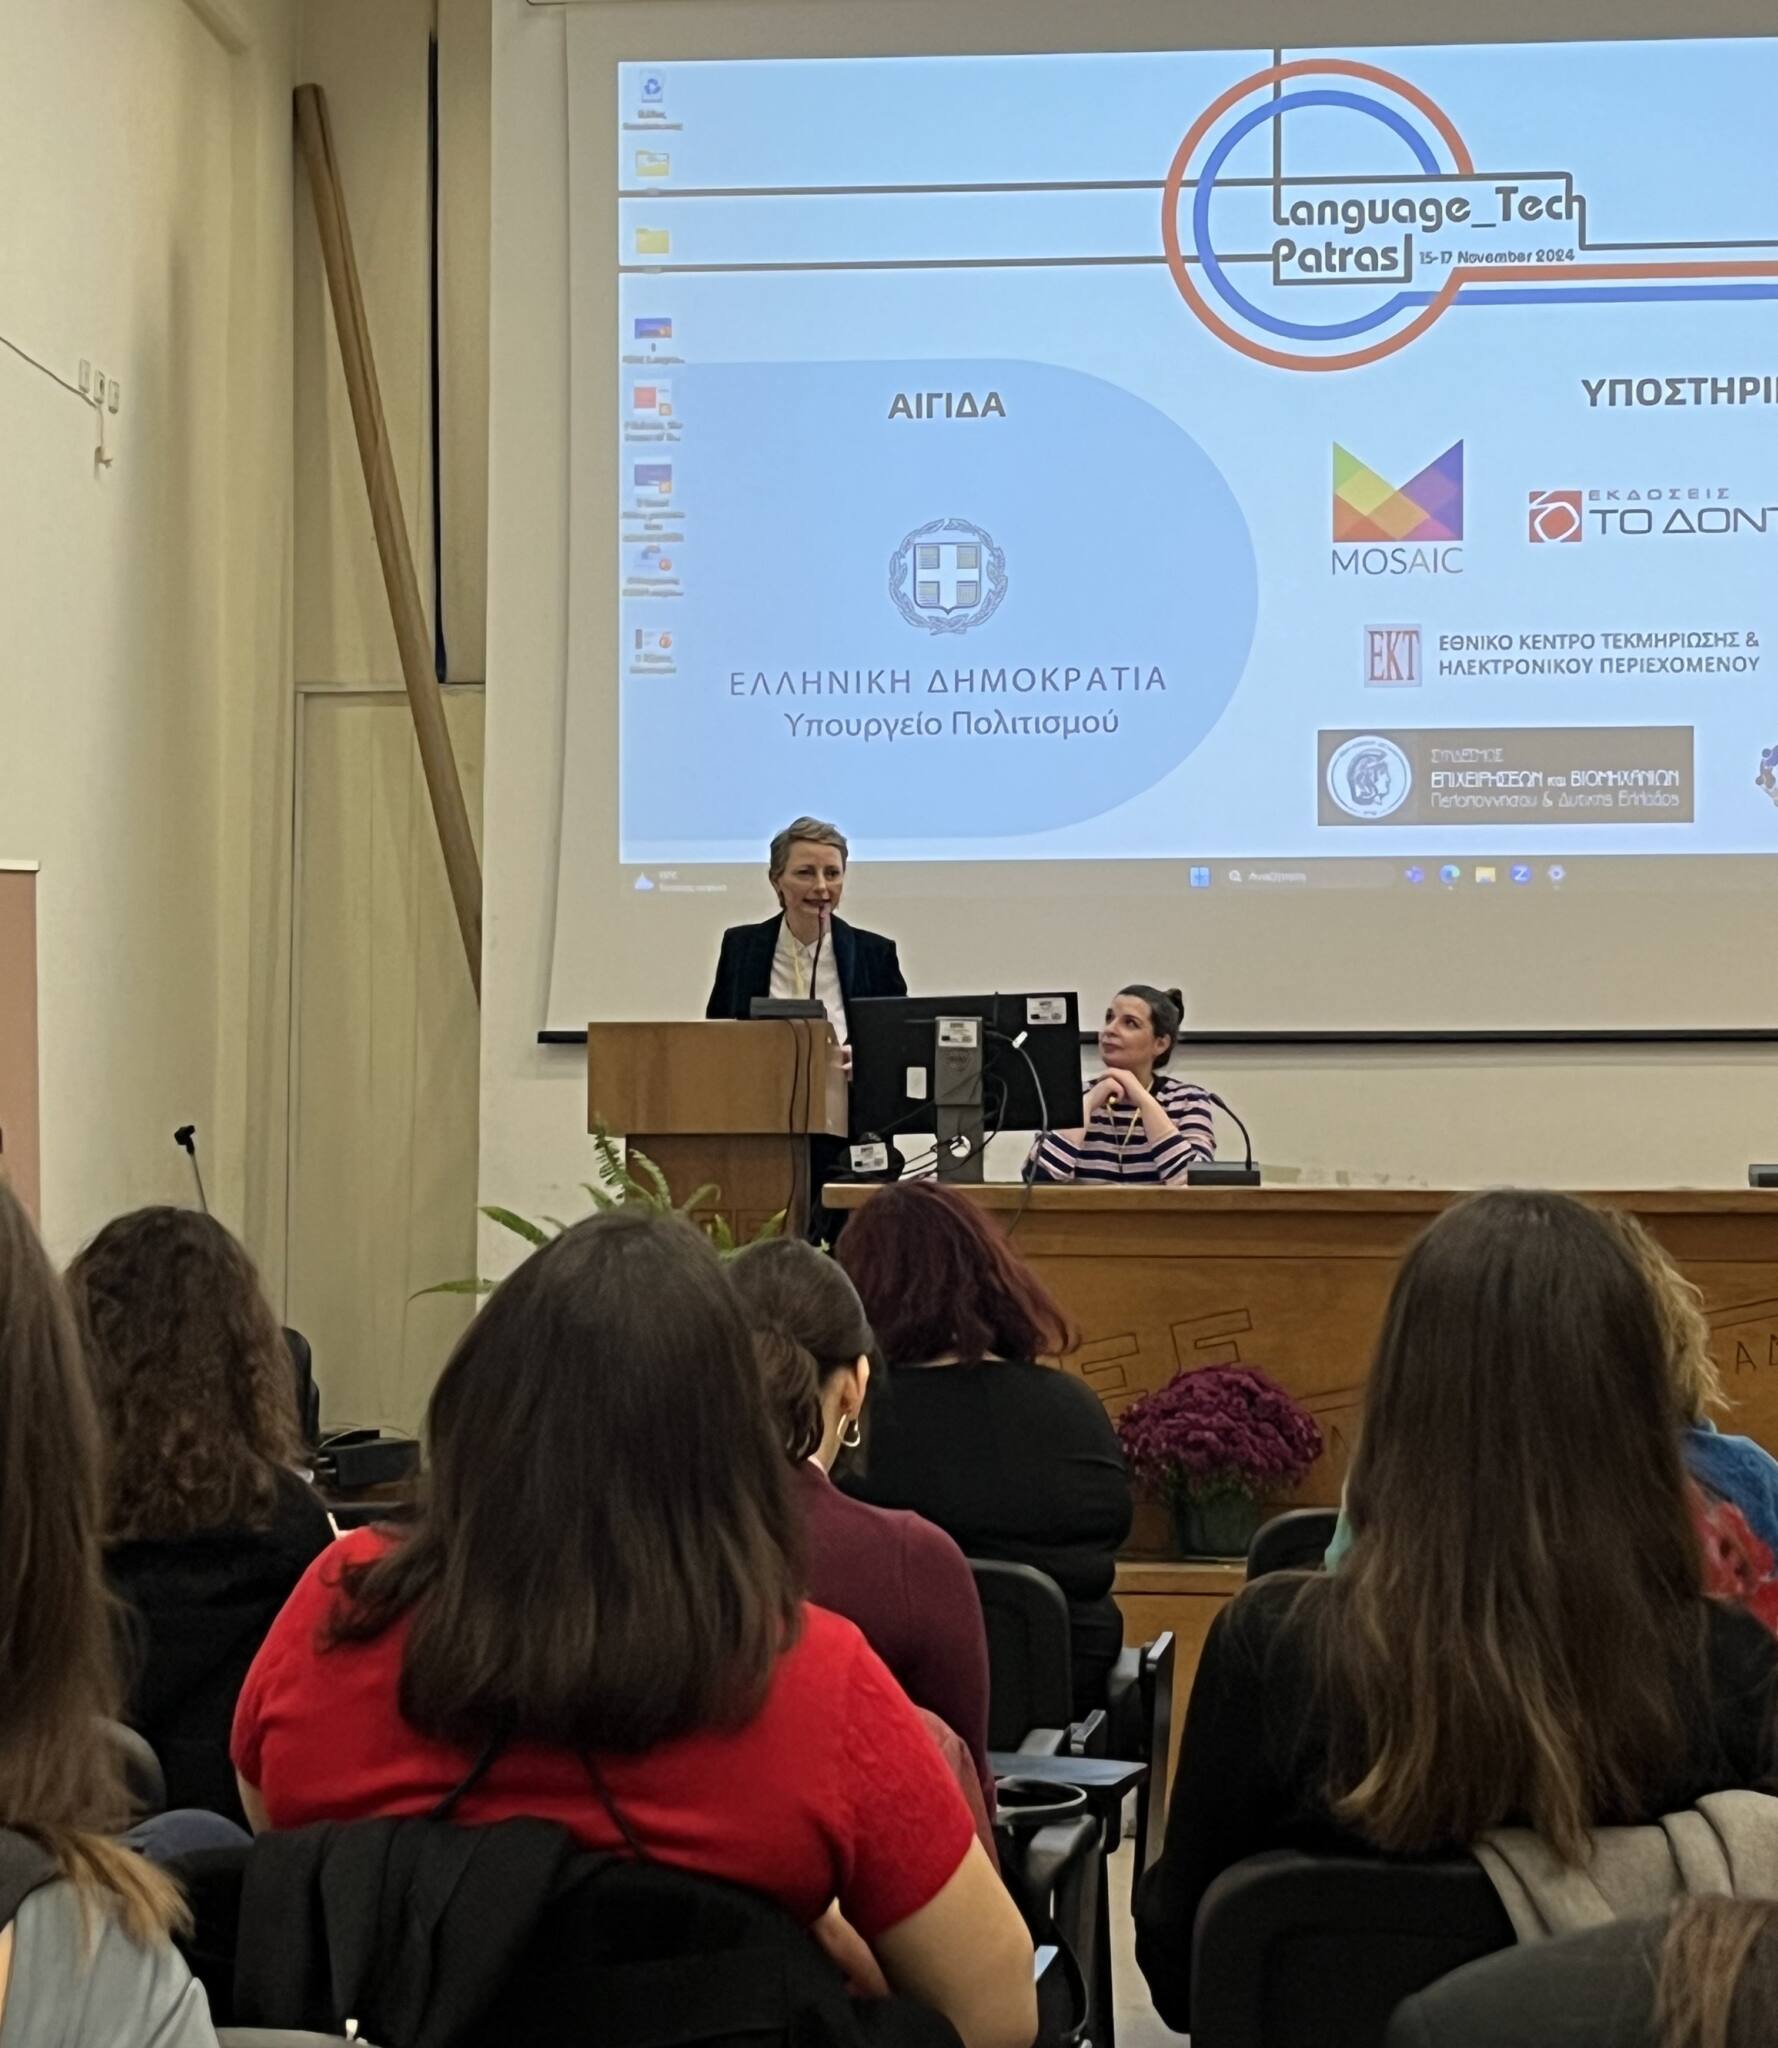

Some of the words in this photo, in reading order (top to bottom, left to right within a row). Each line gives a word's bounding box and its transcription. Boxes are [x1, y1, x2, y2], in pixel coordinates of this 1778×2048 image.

[1273, 186, 1586, 234] Language_Tech
[1273, 238, 1399, 274] Patras
[1419, 251, 1453, 265] 15-17
[1458, 249, 1532, 264] November
[1536, 248, 1576, 263] 2024
[888, 391, 1007, 420] ΑΙΓΙΔΑ
[1581, 376, 1778, 408] ΥΠΟΣΤΗΡΙ
[1588, 488, 1730, 502] ΕΚΔΟΣΕΙΣ
[1589, 508, 1653, 535] ΤΟ
[1332, 547, 1464, 576] MOSAIC
[1368, 630, 1420, 681] ΕΚΤ
[1439, 635, 1513, 652] ΕΘΝΙΚΟ
[1519, 634, 1596, 651] ΚΕΝΤΡΟ
[1601, 632, 1740, 650] ΤΕΚΜΗΡΙΩΣΗΣ
[1745, 632, 1760, 648] &
[729, 669, 912, 697] ΕΛΛΗΝΙΚΗ
[927, 665, 1168, 695] ΔΗΜΟΚΡΑΤΙΑ
[1439, 659, 1593, 677] ΗΛΕΚΤΡΟΝΙΚΟΥ
[1600, 656, 1760, 675] ΠΕΡΙΕΧΟΜΕΝΟΥ
[784, 710, 943, 742] Υπουργείο
[952, 709, 1120, 741] Πολιτισμού
